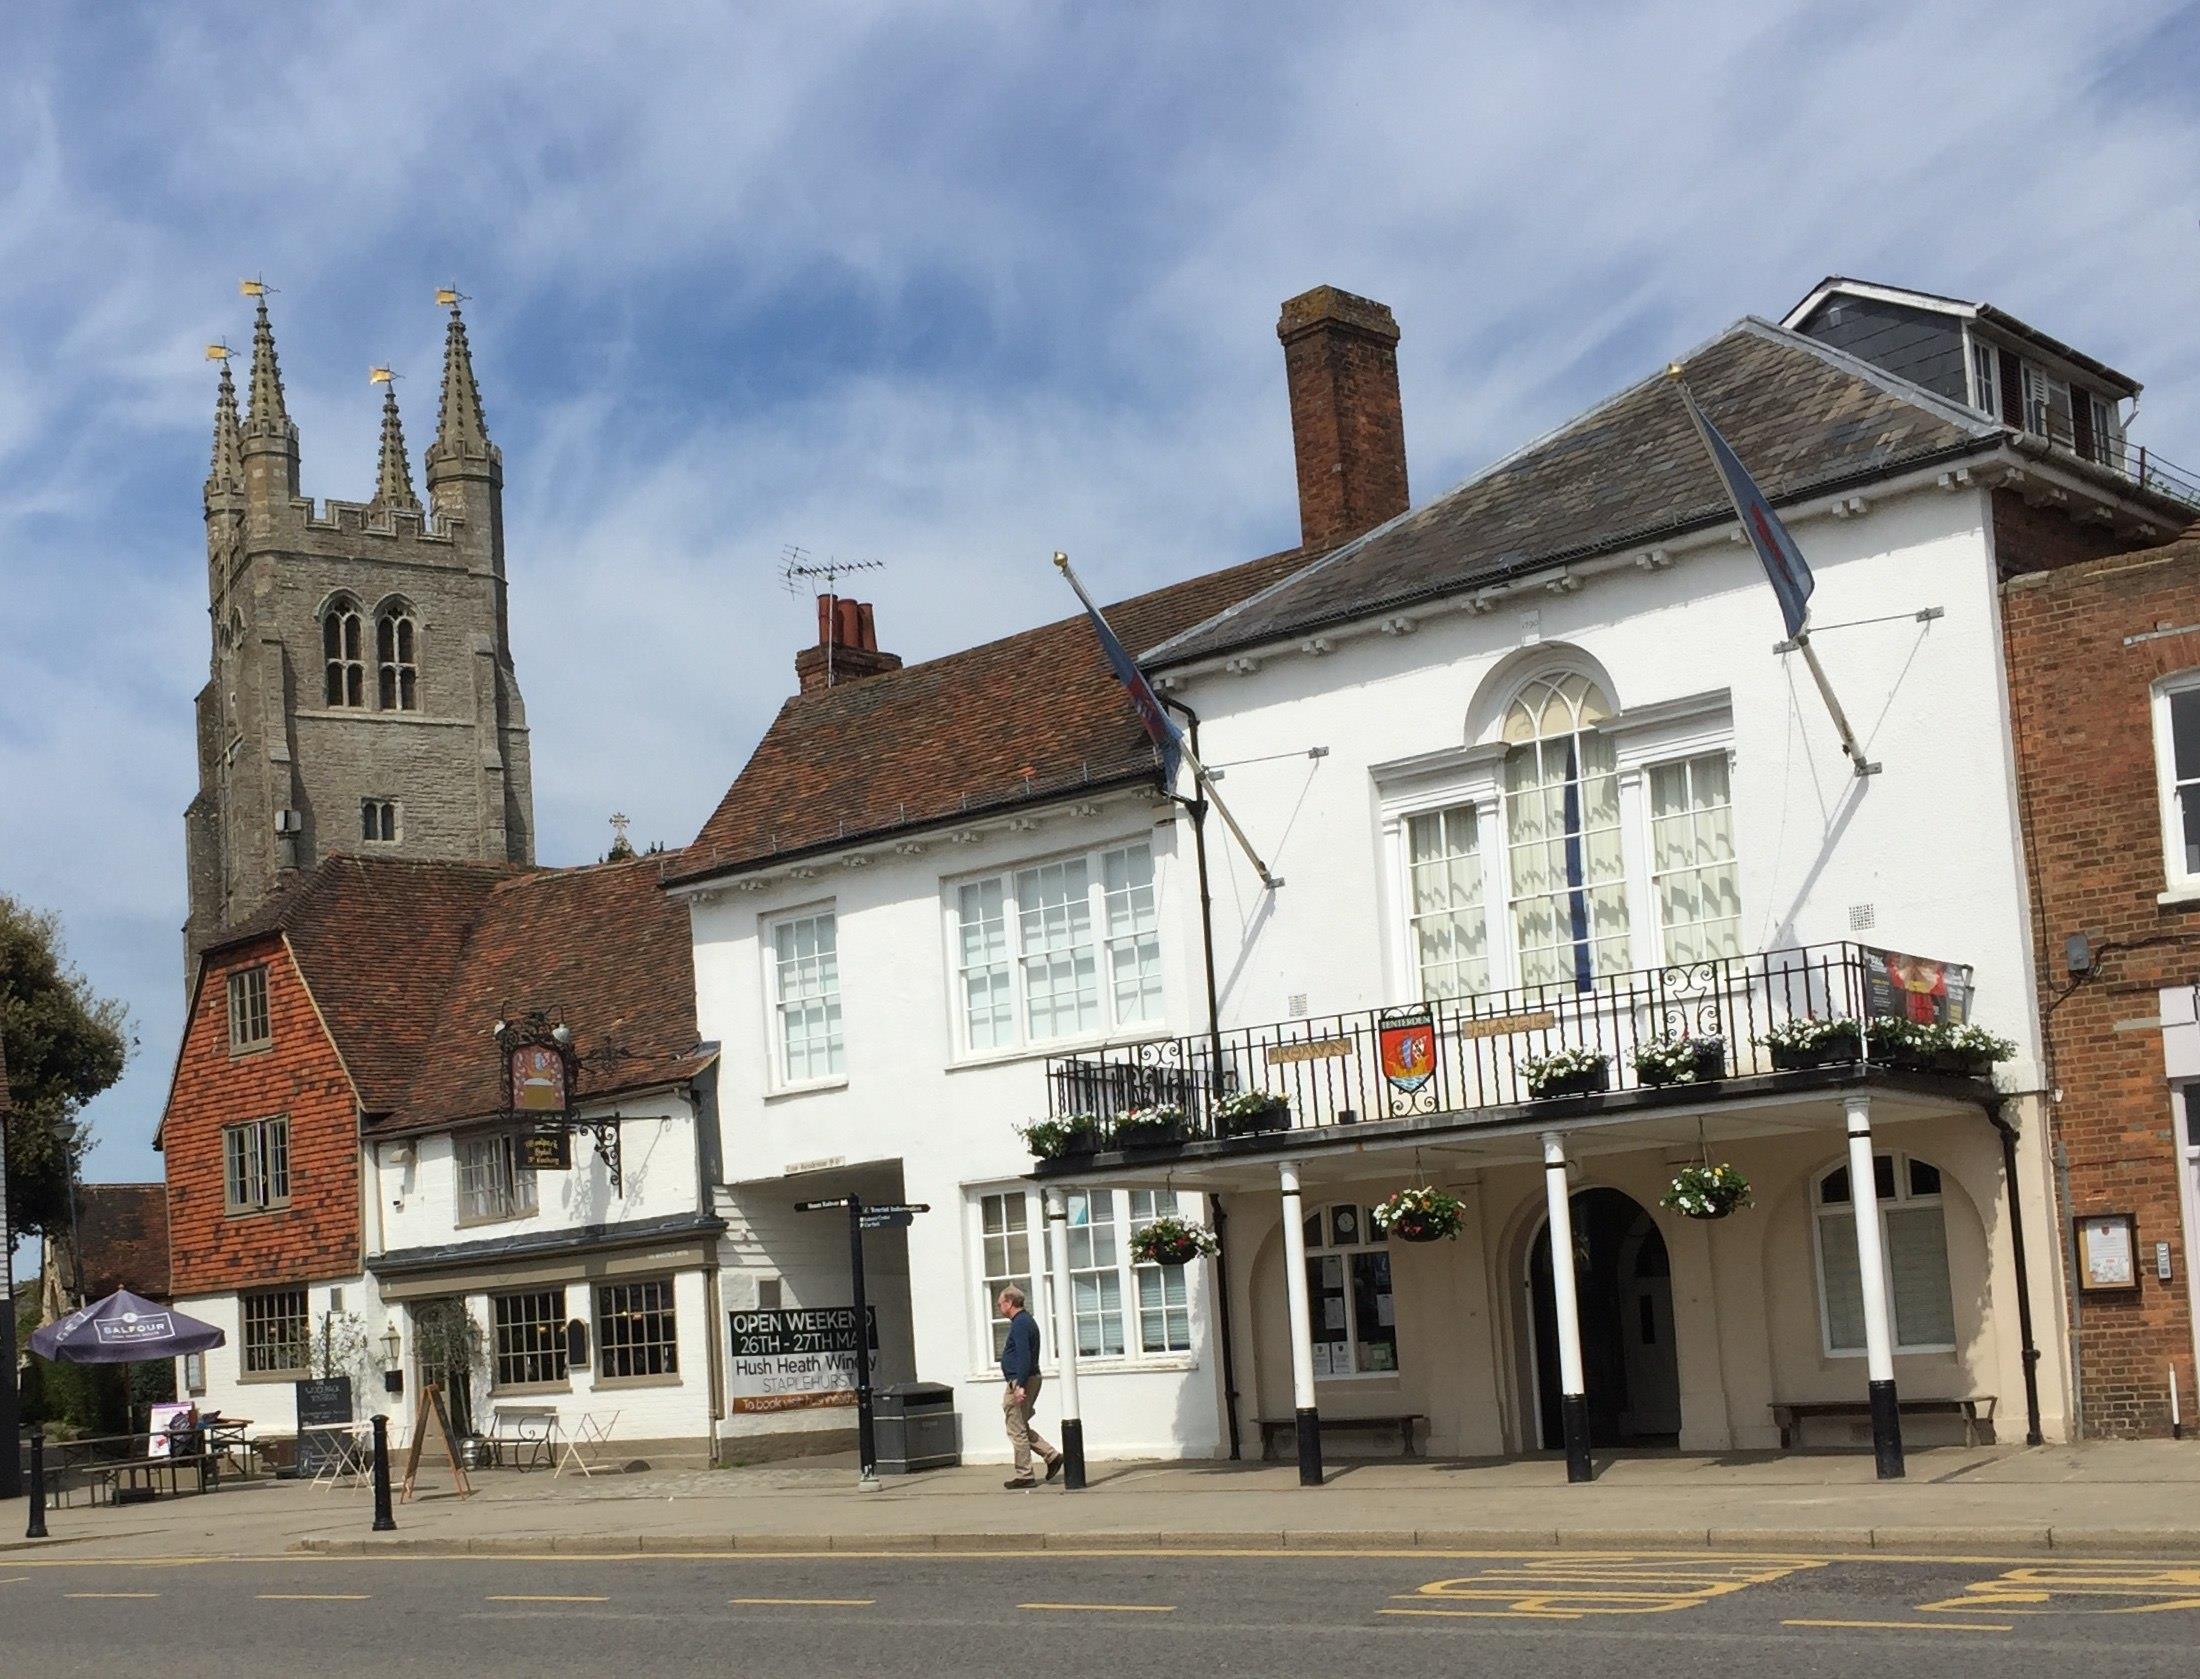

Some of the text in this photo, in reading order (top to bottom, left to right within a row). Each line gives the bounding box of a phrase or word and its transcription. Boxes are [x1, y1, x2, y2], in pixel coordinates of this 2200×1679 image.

[1470, 1013, 1552, 1037] HALL
[1272, 1039, 1349, 1063] TOWN
[103, 1323, 165, 1334] BALFOUR
[733, 1314, 782, 1333] OPEN
[740, 1335, 780, 1354] 26TH
[793, 1333, 832, 1351] 27TH
[736, 1358, 772, 1375] Hush
[777, 1355, 821, 1373] Heath
[762, 1373, 854, 1393] STAPLEHURST
[742, 1399, 755, 1410] To
[756, 1397, 782, 1410] book
